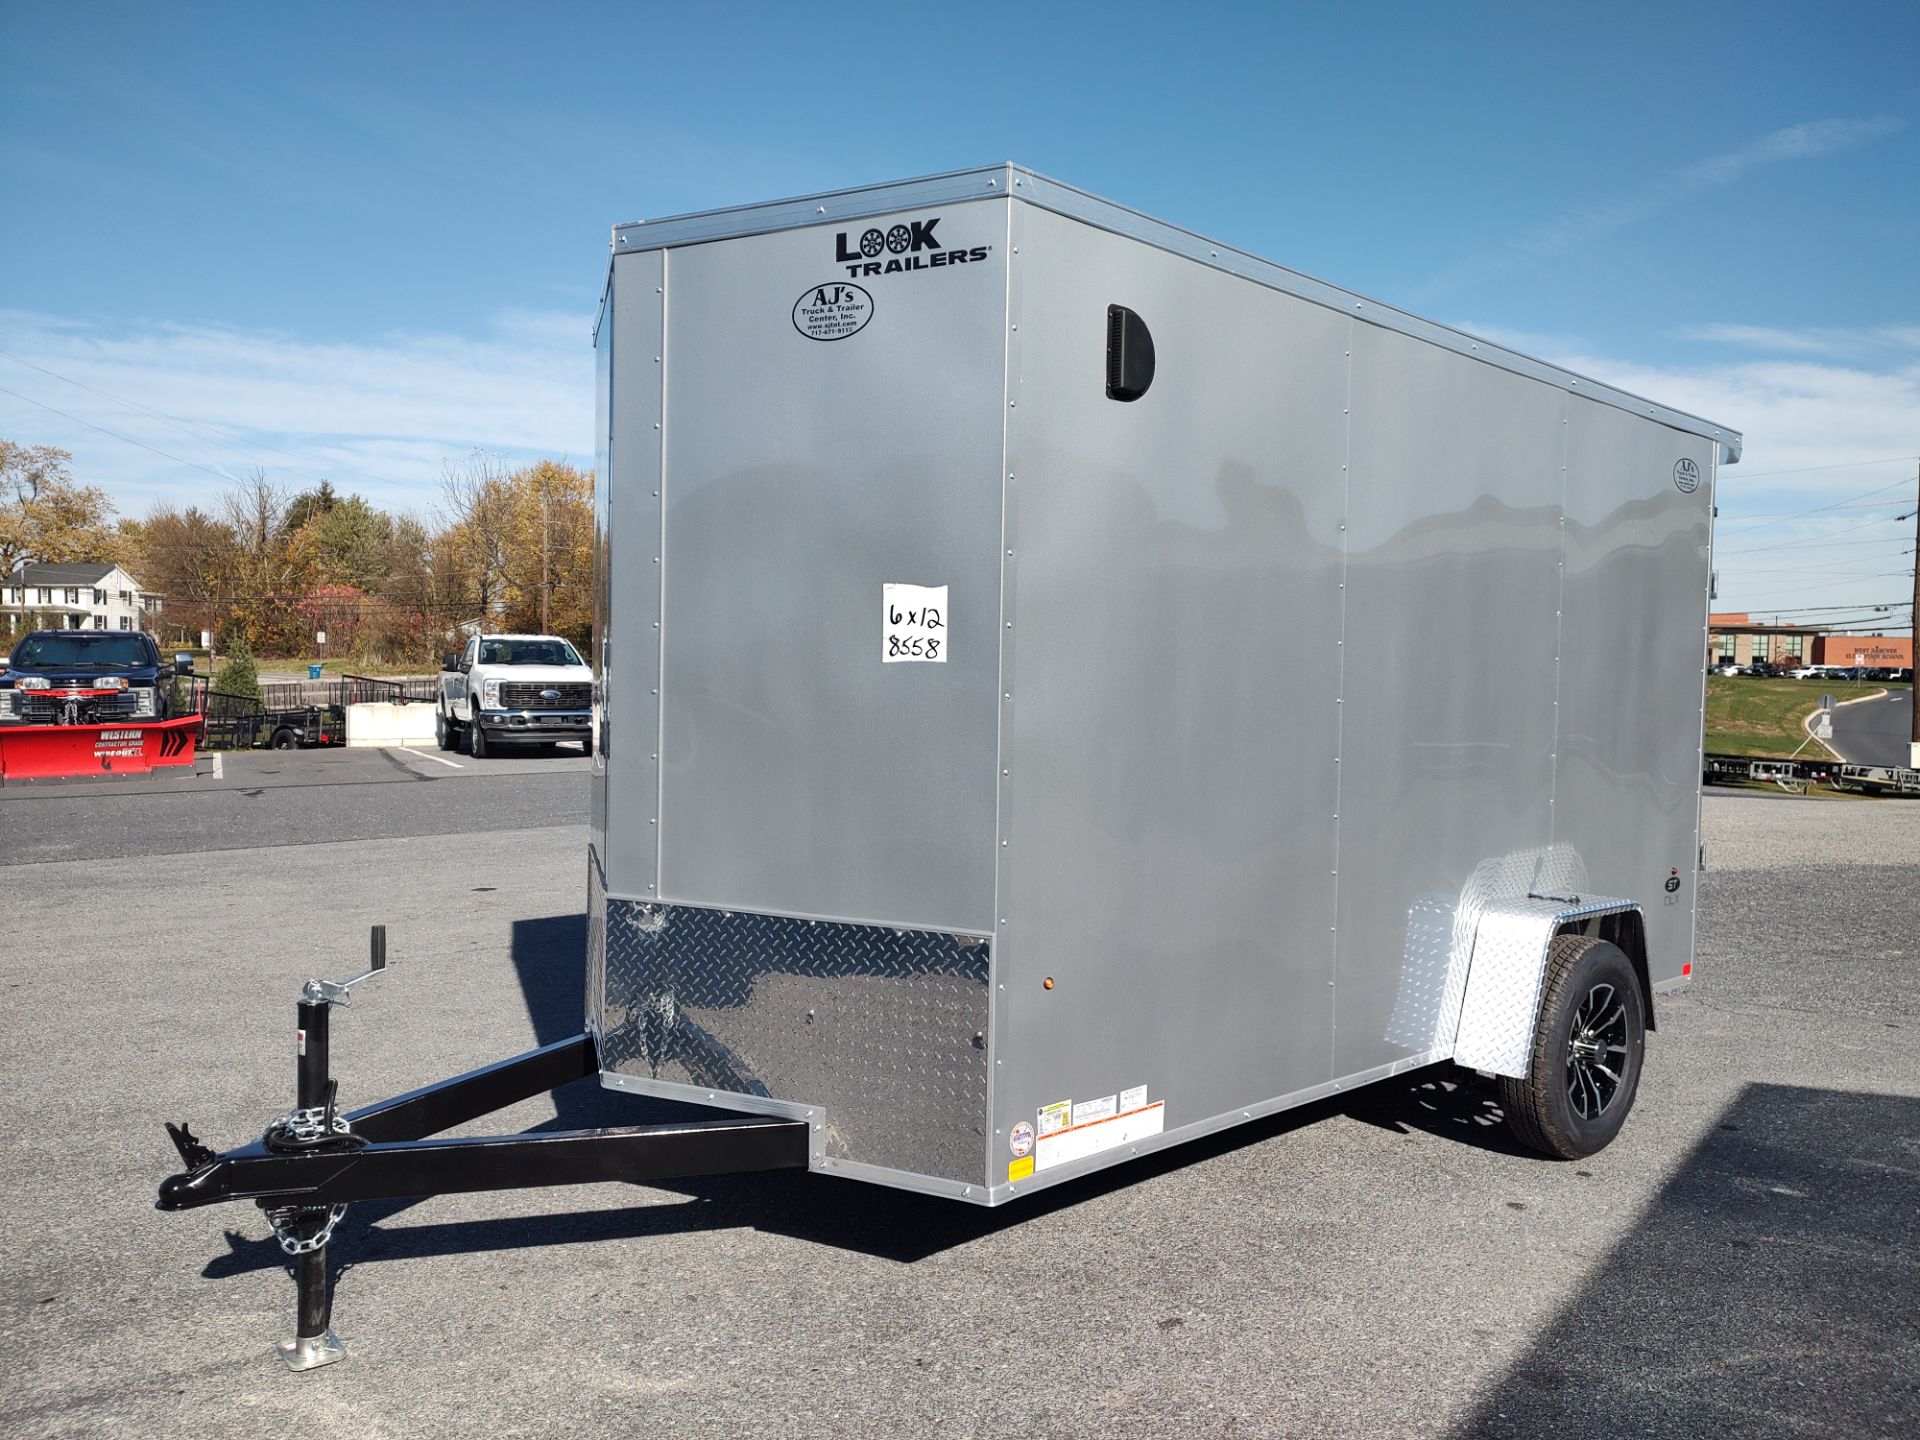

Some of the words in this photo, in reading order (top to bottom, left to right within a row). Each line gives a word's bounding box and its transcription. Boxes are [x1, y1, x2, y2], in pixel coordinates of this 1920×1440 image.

[836, 218, 942, 262] LOOK
[846, 246, 988, 278] TRAILERS
[812, 286, 854, 307] AJ's
[801, 307, 825, 315] Truck
[836, 304, 865, 312] Trailer
[808, 315, 838, 323] Center,
[888, 634, 941, 659] 8558
[101, 730, 142, 740] WESTERN
